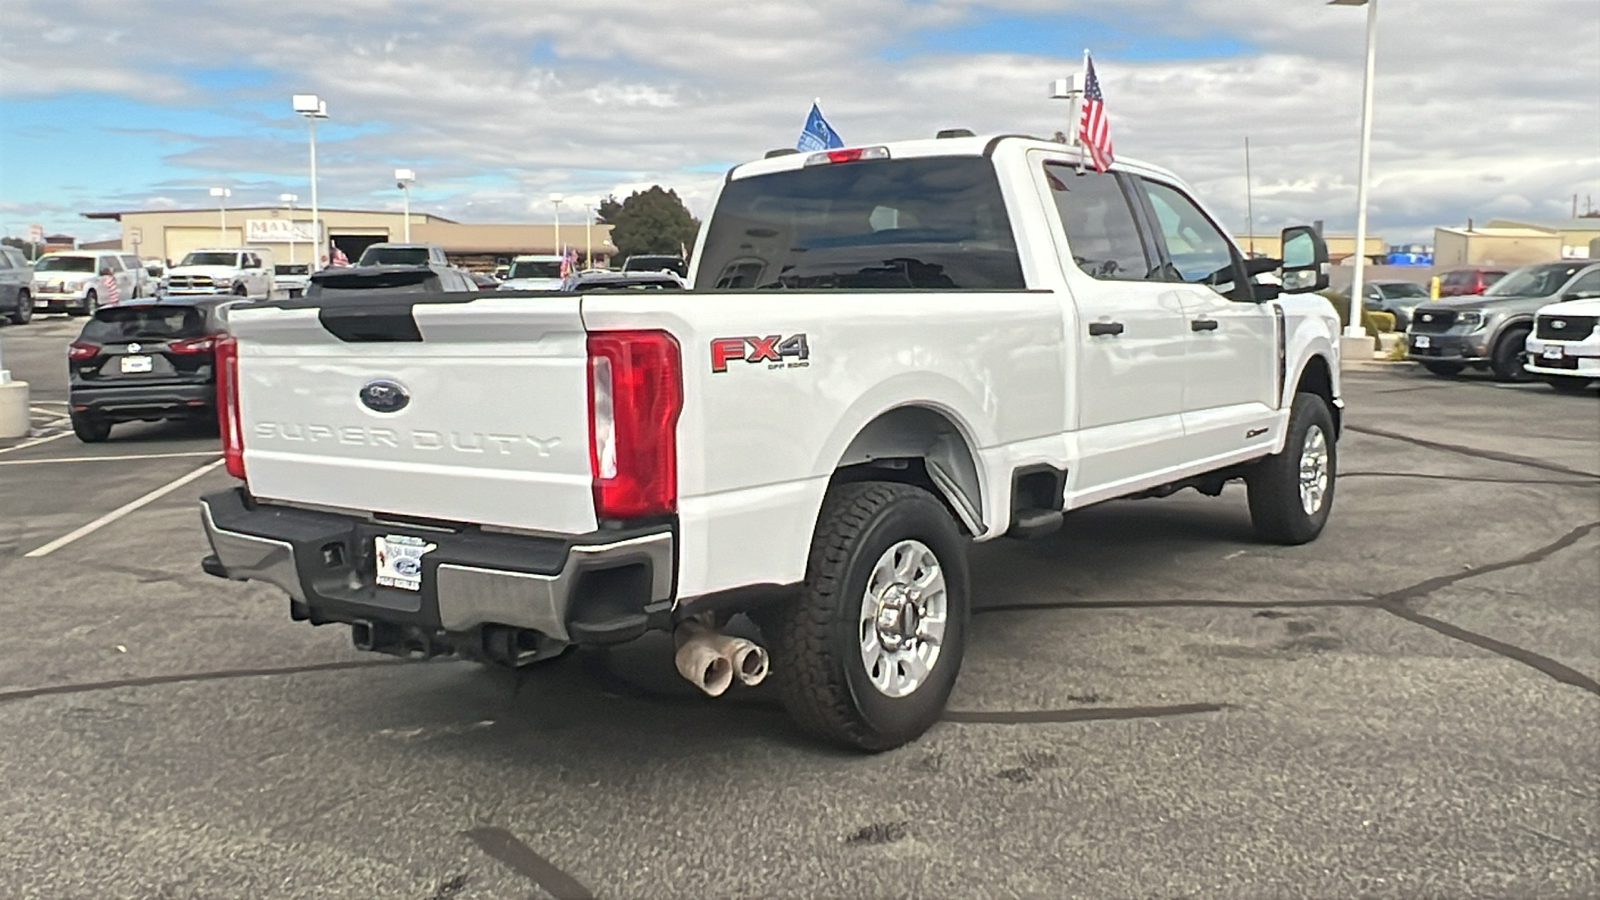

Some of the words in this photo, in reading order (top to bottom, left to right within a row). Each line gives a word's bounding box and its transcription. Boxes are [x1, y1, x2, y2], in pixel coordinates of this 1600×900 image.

[710, 333, 809, 373] FX4
[787, 361, 809, 369] ROAD
[255, 422, 399, 448] SUPER
[412, 429, 562, 457] DUTY
